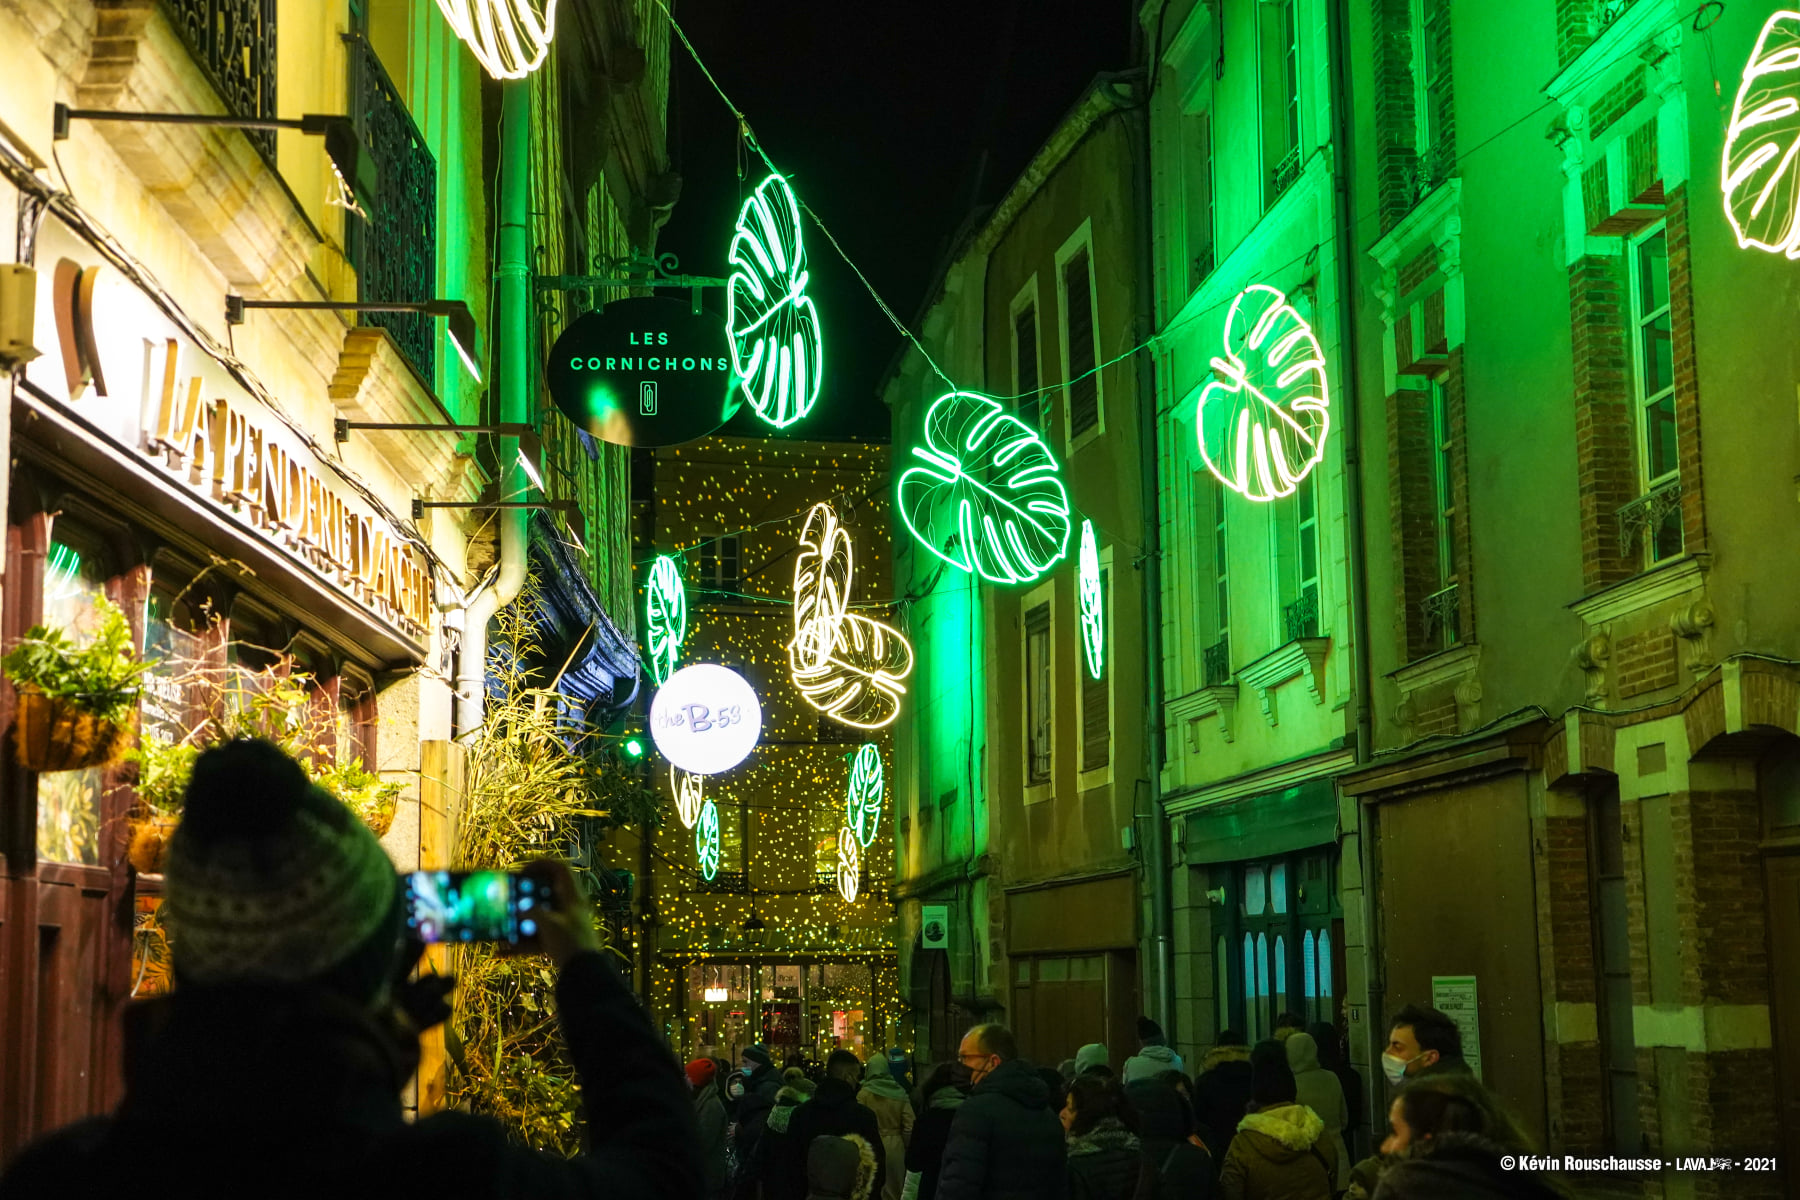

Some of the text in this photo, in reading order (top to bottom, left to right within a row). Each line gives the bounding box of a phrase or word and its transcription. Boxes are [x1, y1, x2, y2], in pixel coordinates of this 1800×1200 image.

[629, 332, 669, 345] LES
[570, 357, 728, 371] CORNICHONS
[156, 337, 214, 472] LA
[213, 398, 354, 572] PENDERIE
[723, 929, 776, 945] PETT
